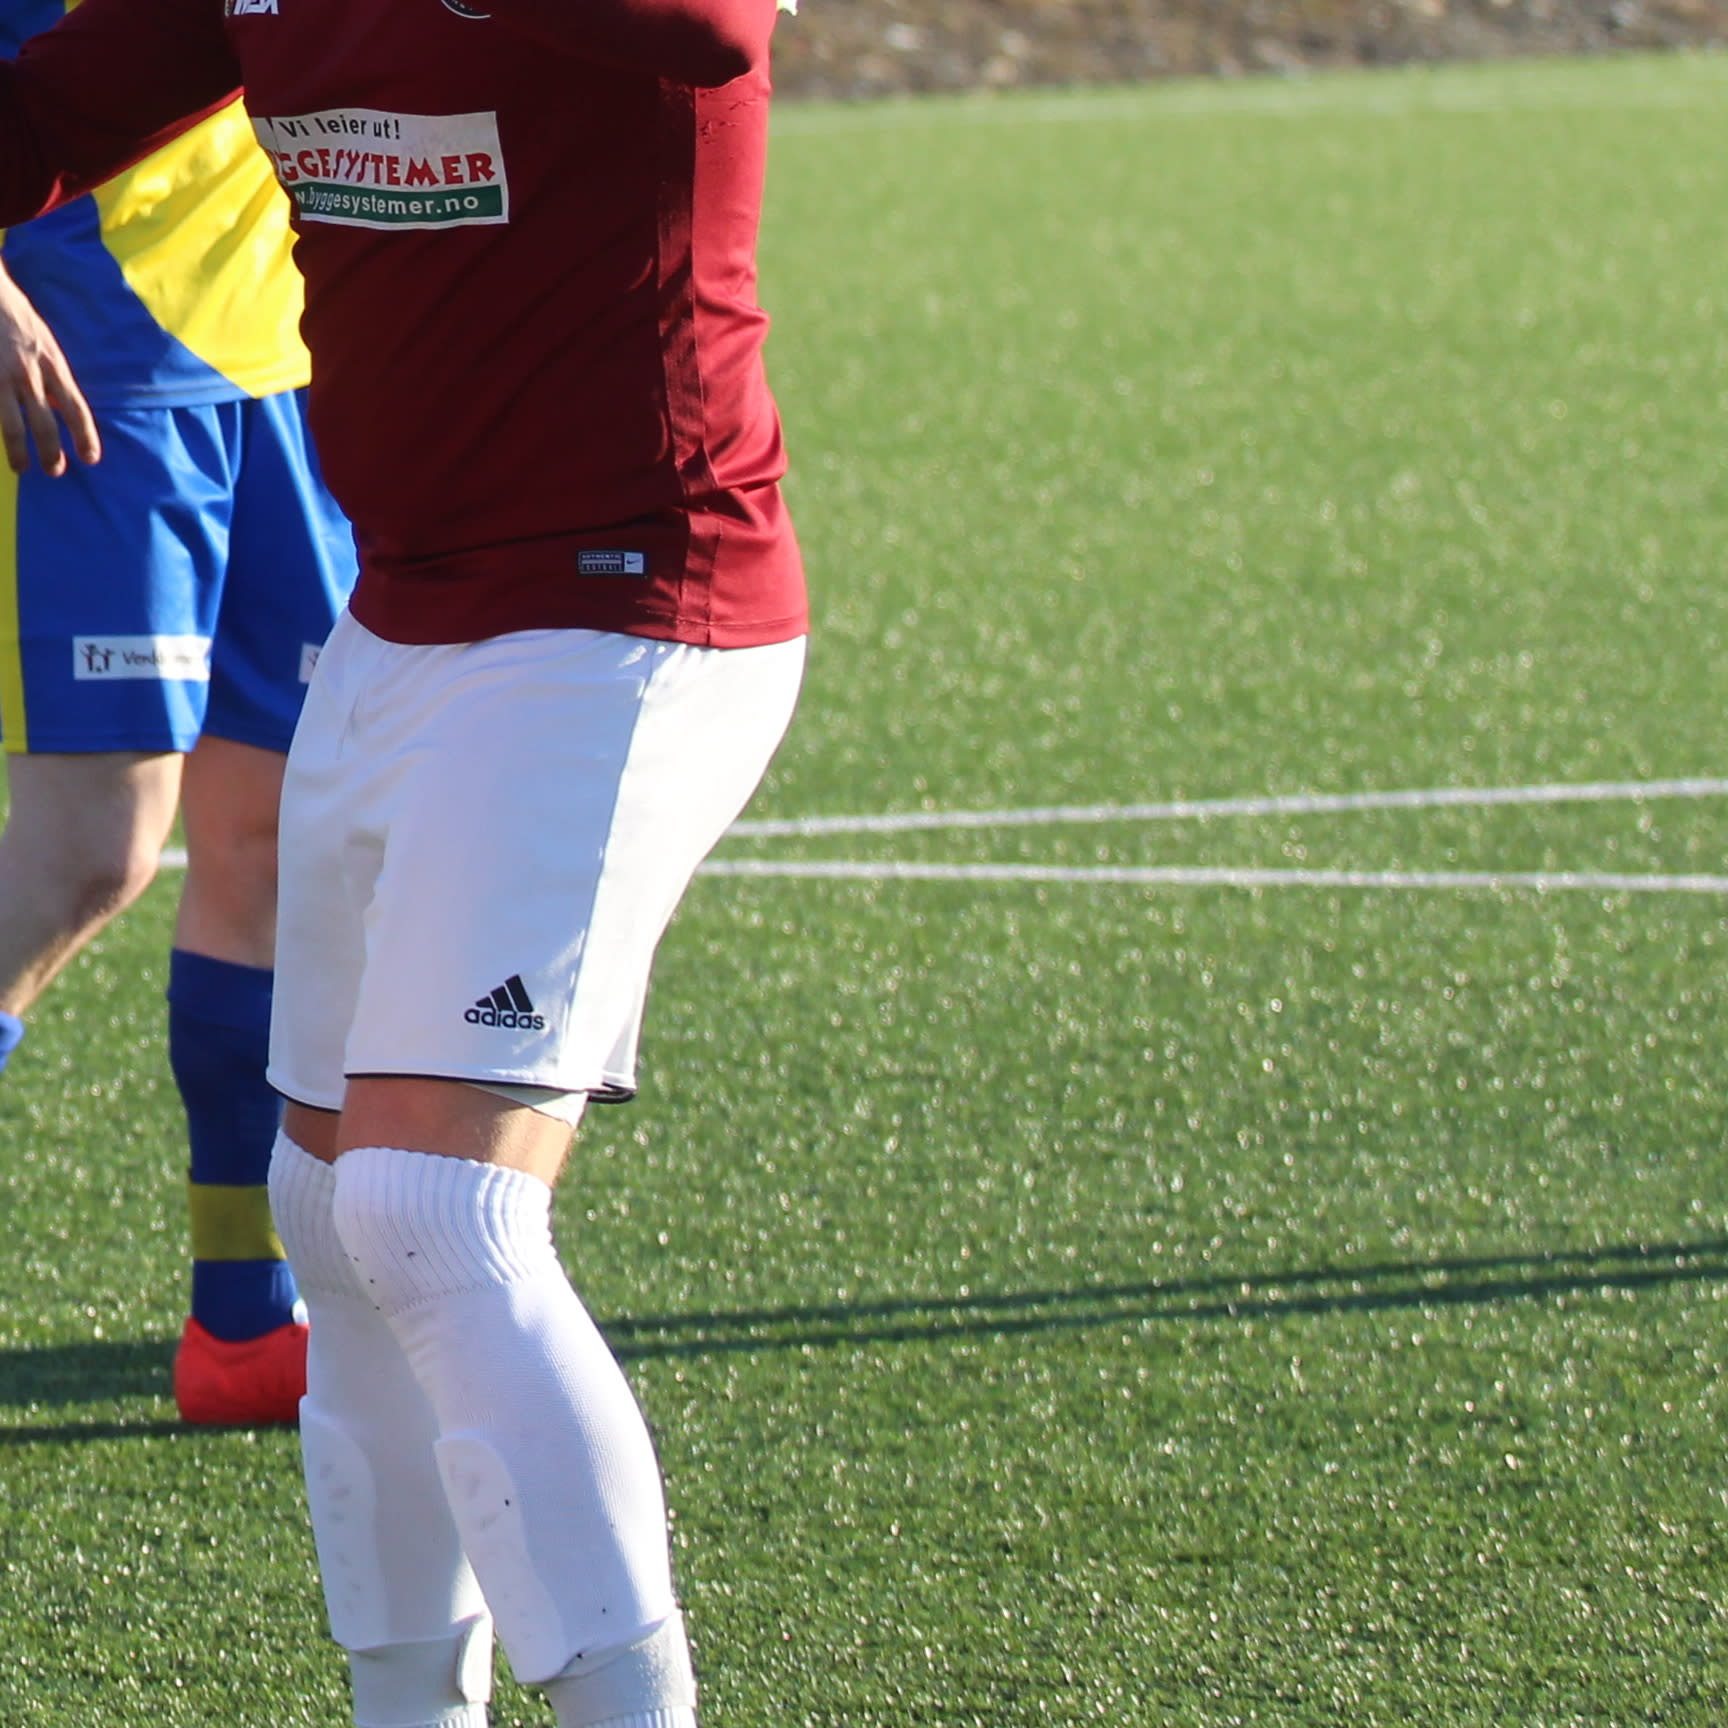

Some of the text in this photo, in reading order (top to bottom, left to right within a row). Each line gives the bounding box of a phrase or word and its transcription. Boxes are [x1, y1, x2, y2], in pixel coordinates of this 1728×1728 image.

[279, 120, 310, 138] Vi
[314, 114, 367, 134] leier
[276, 147, 497, 189] GGESYSTEMER
[464, 1008, 545, 1030] adidas
